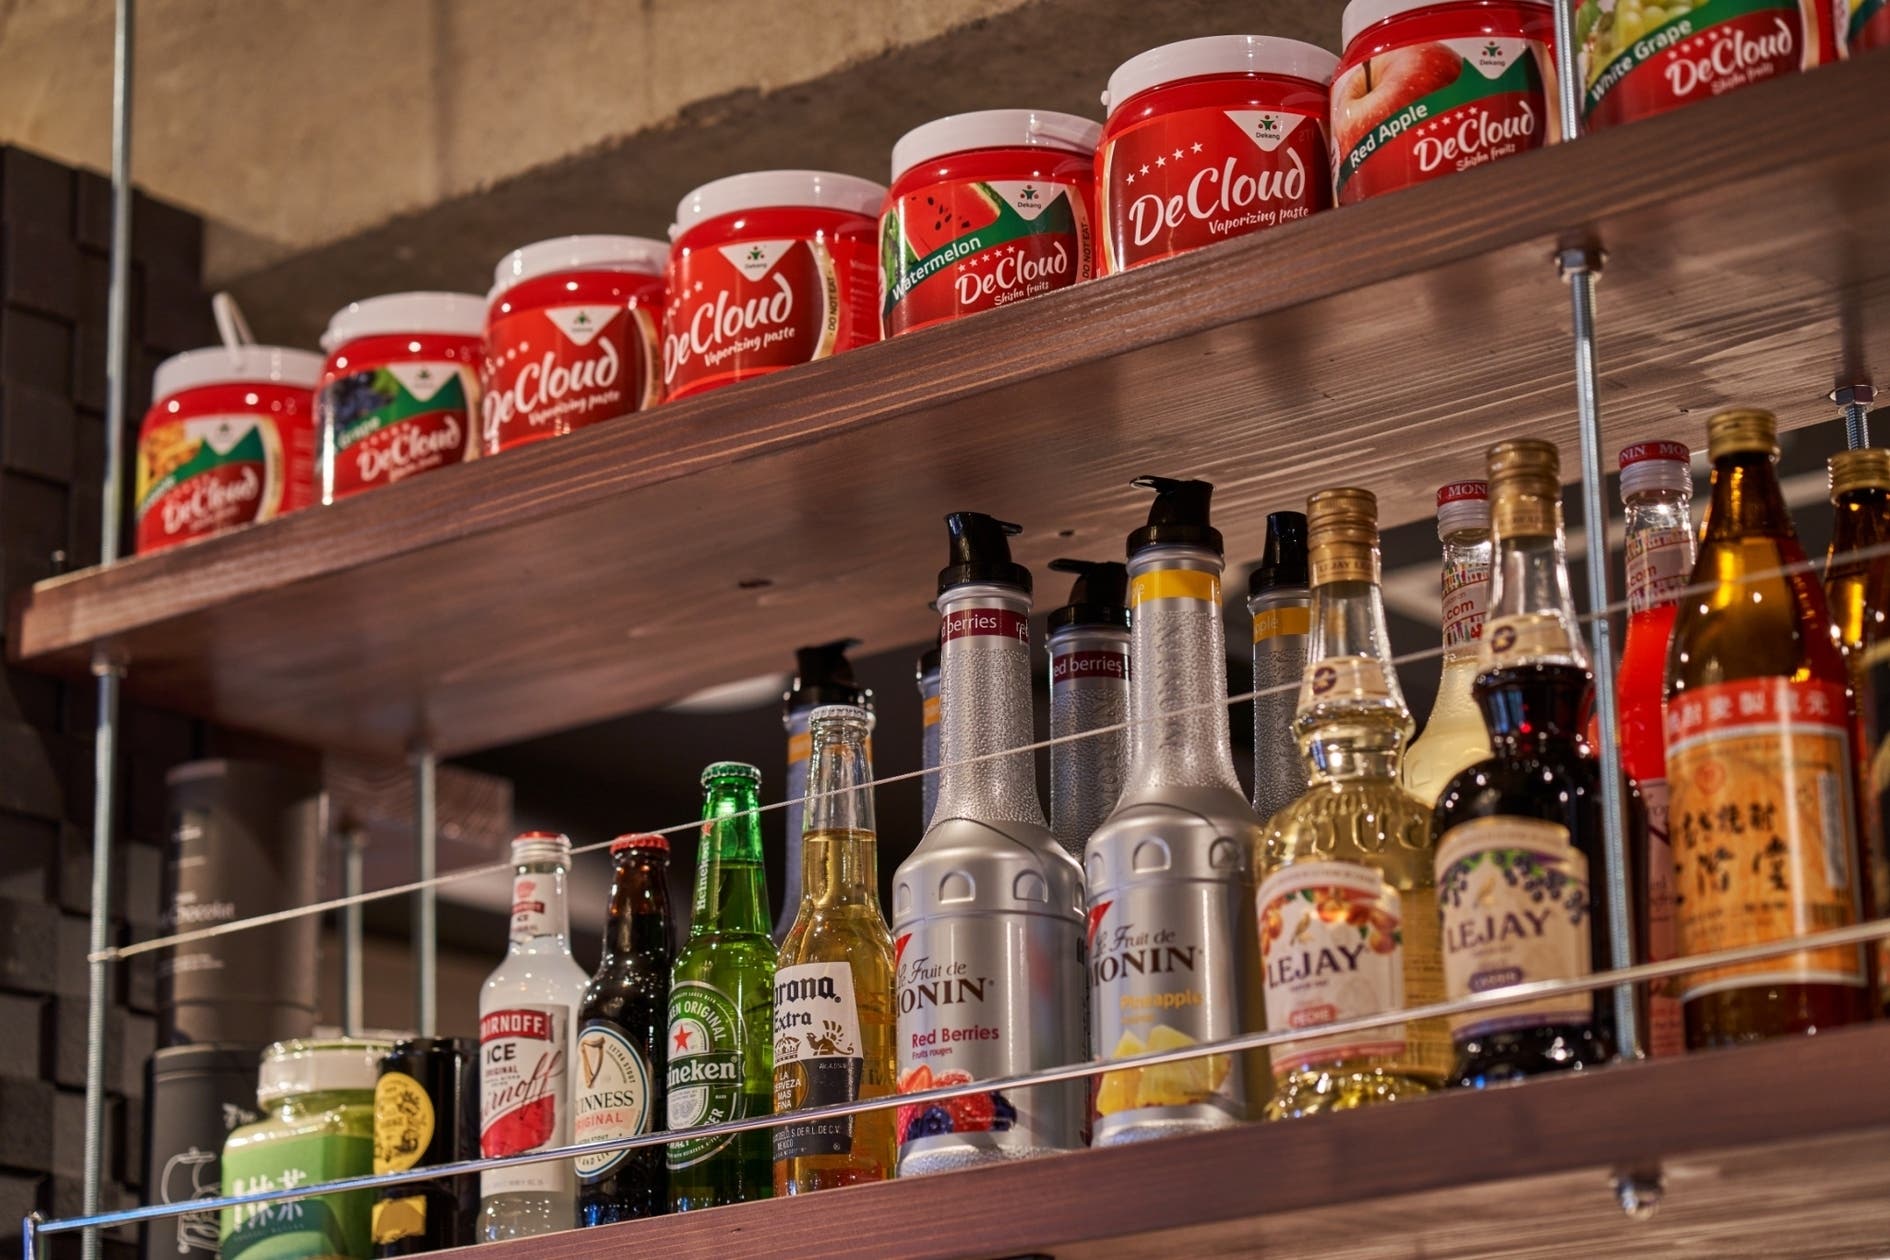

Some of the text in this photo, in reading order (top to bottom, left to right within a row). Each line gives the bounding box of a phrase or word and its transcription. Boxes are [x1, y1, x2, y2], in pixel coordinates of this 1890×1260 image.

[1591, 20, 1693, 101] White Grape
[1665, 17, 1794, 96] DeCloud
[1255, 131, 1281, 141] Dekang
[1349, 104, 1428, 168] Red Apple
[1413, 100, 1535, 172] DeCloud
[1017, 201, 1042, 210] Dekang
[1129, 147, 1306, 246] DeCloud
[1208, 205, 1309, 235] Vaporizing paste
[892, 237, 982, 300] Watermelon
[955, 241, 1068, 305] DeCloud
[1082, 242, 1091, 263] NOT
[994, 281, 1049, 306] Shisha fruits
[664, 272, 793, 385] DeCloud
[704, 326, 796, 367] Vaporizing paste
[482, 336, 619, 442] DeCloud
[356, 415, 461, 482] DeCloud
[947, 614, 997, 634] berries
[1069, 656, 1122, 674] berries
[1153, 929, 1177, 945] de
[1447, 909, 1553, 954] LEJAY
[908, 956, 943, 984] Fruit
[946, 961, 967, 977] de
[1268, 943, 1366, 989] LEJAY
[684, 1000, 727, 1042] ORIGINAL
[912, 1025, 1000, 1049] Red Berries
[487, 1043, 516, 1064] ICE
[929, 1046, 953, 1058] rouges
